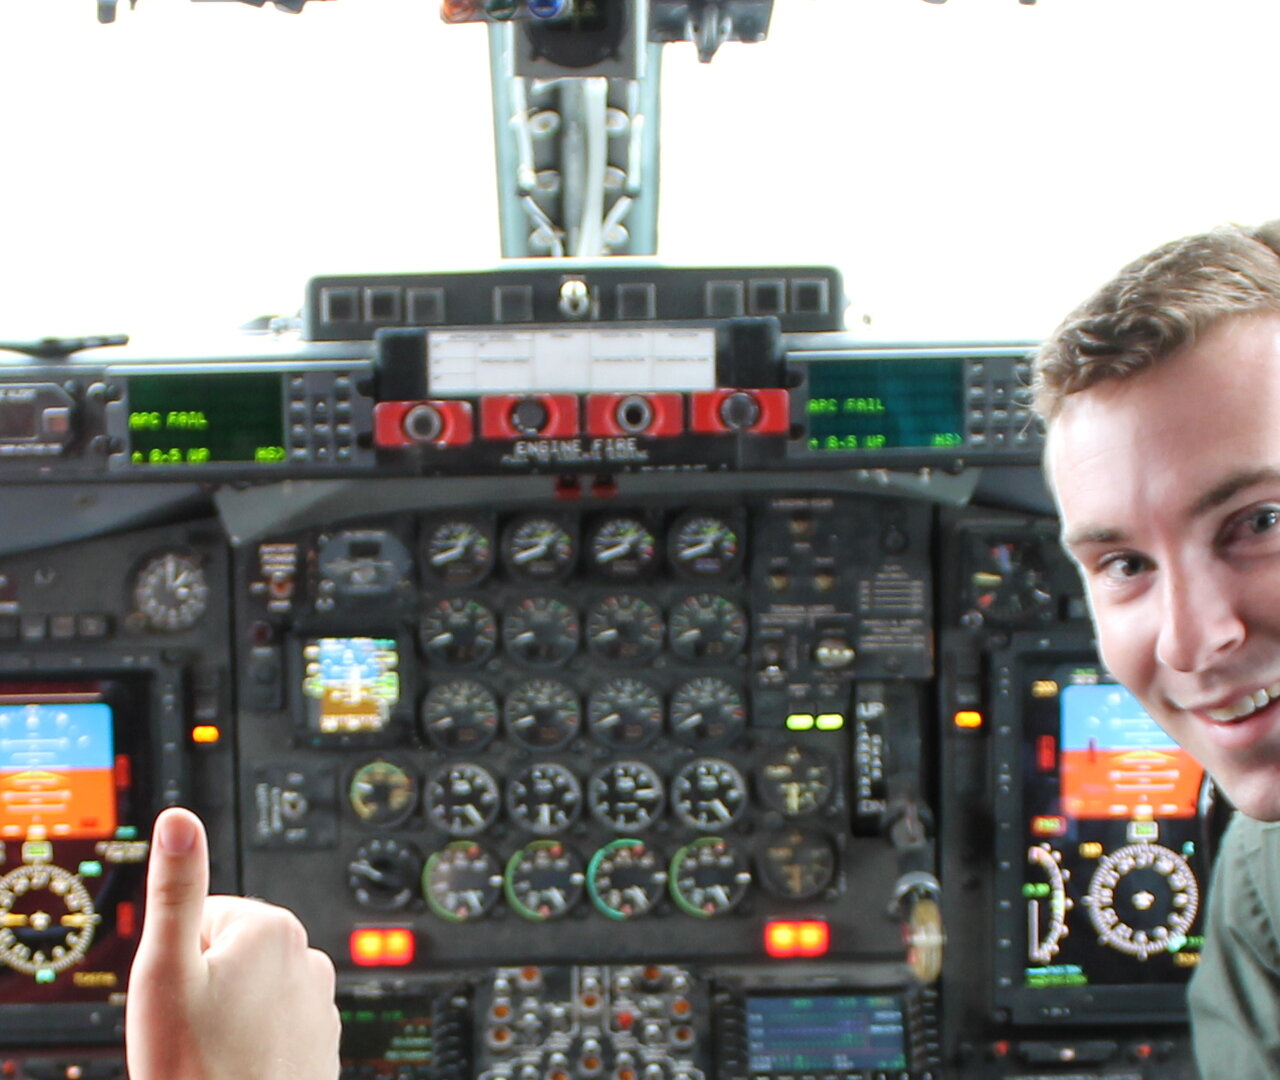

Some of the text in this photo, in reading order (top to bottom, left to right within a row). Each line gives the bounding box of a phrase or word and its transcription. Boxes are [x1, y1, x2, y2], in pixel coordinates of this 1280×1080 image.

[843, 397, 885, 413] FAIL
[167, 411, 207, 429] FAIL
[514, 437, 637, 456] ENGINE FIRE
[857, 702, 885, 718] UP
